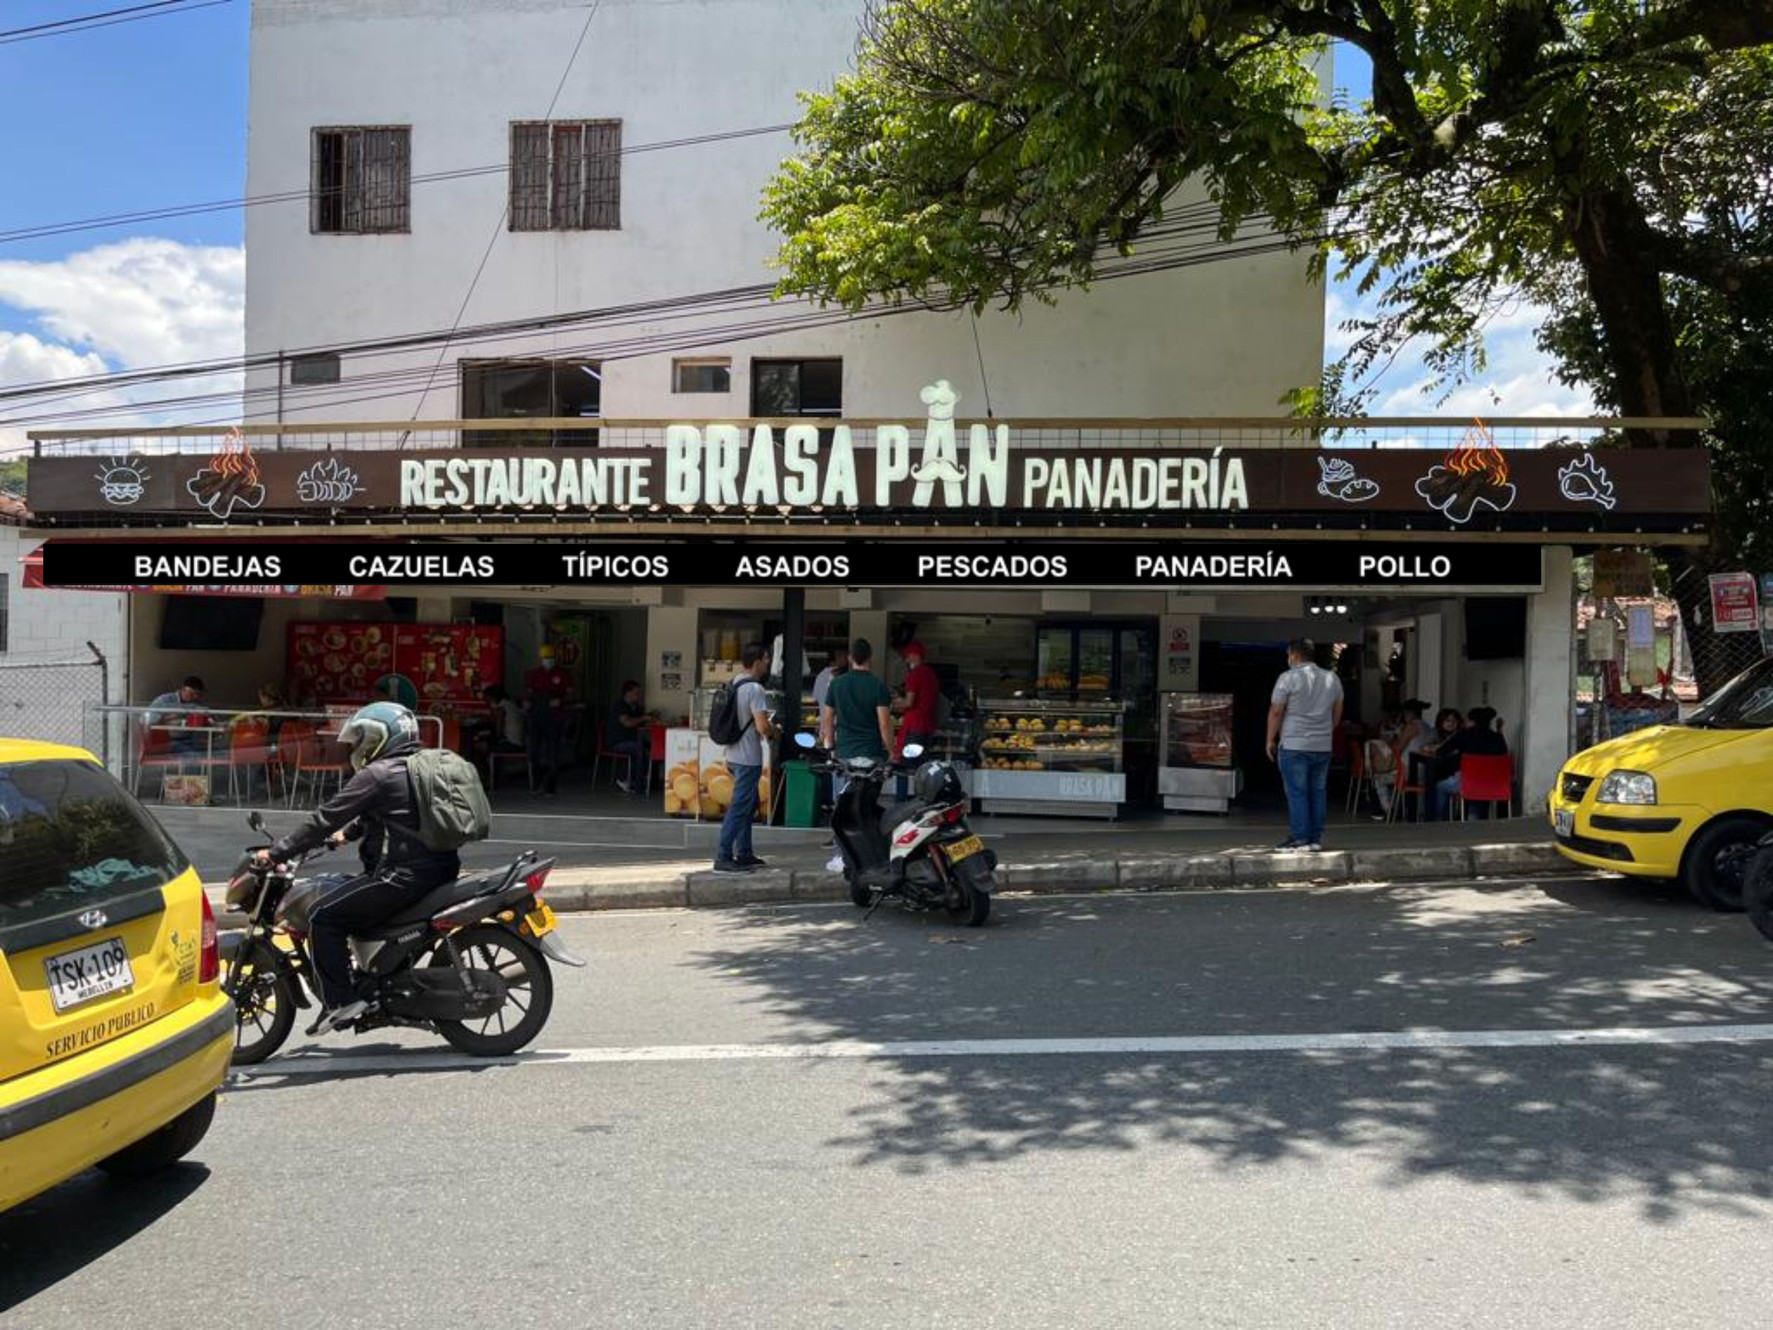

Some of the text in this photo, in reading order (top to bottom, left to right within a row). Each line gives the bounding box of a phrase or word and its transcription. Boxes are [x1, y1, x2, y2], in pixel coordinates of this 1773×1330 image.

[400, 422, 1248, 510] RESTAURANTE BRASA PAN PANADERÍA
[134, 550, 1451, 578] BANDEJAS CAZUELAS TÍPICOS ASADOS PESCADOS PANADERÍA POLLO
[45, 1003, 154, 1058] SERVICIO PUBLICO
